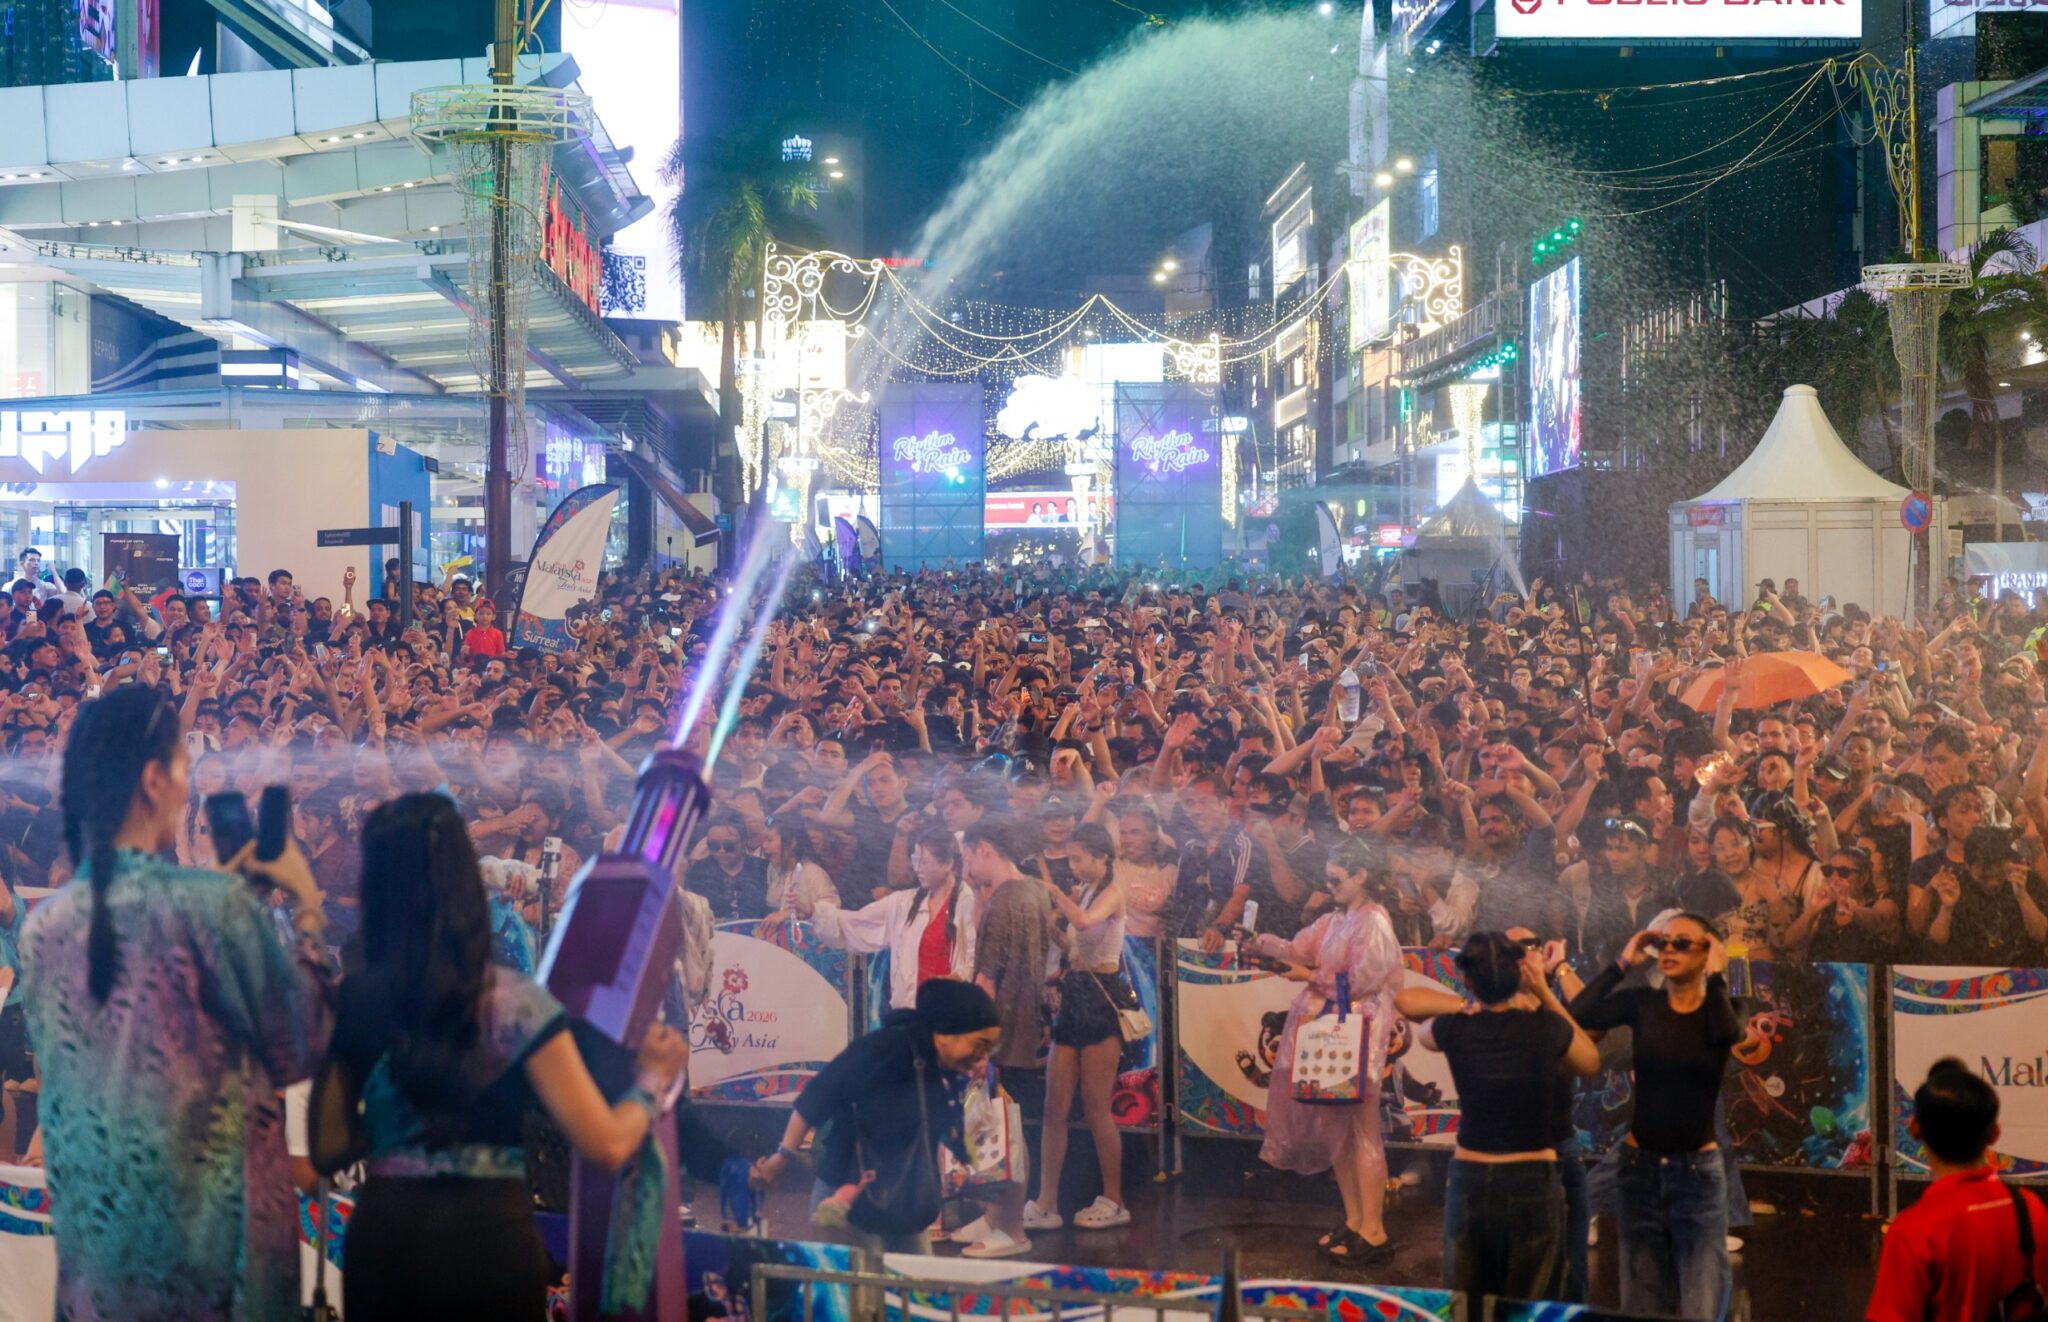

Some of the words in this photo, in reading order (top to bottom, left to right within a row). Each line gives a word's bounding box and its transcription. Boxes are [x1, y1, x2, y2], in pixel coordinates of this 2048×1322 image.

[893, 430, 955, 462] Rhythm
[1131, 429, 1193, 461] Rhythm
[922, 447, 972, 473] Rain
[1161, 446, 1209, 473] Rain
[523, 630, 560, 648] Surreal
[742, 1033, 777, 1049] Asia
[1981, 1056, 2048, 1087] Mal
